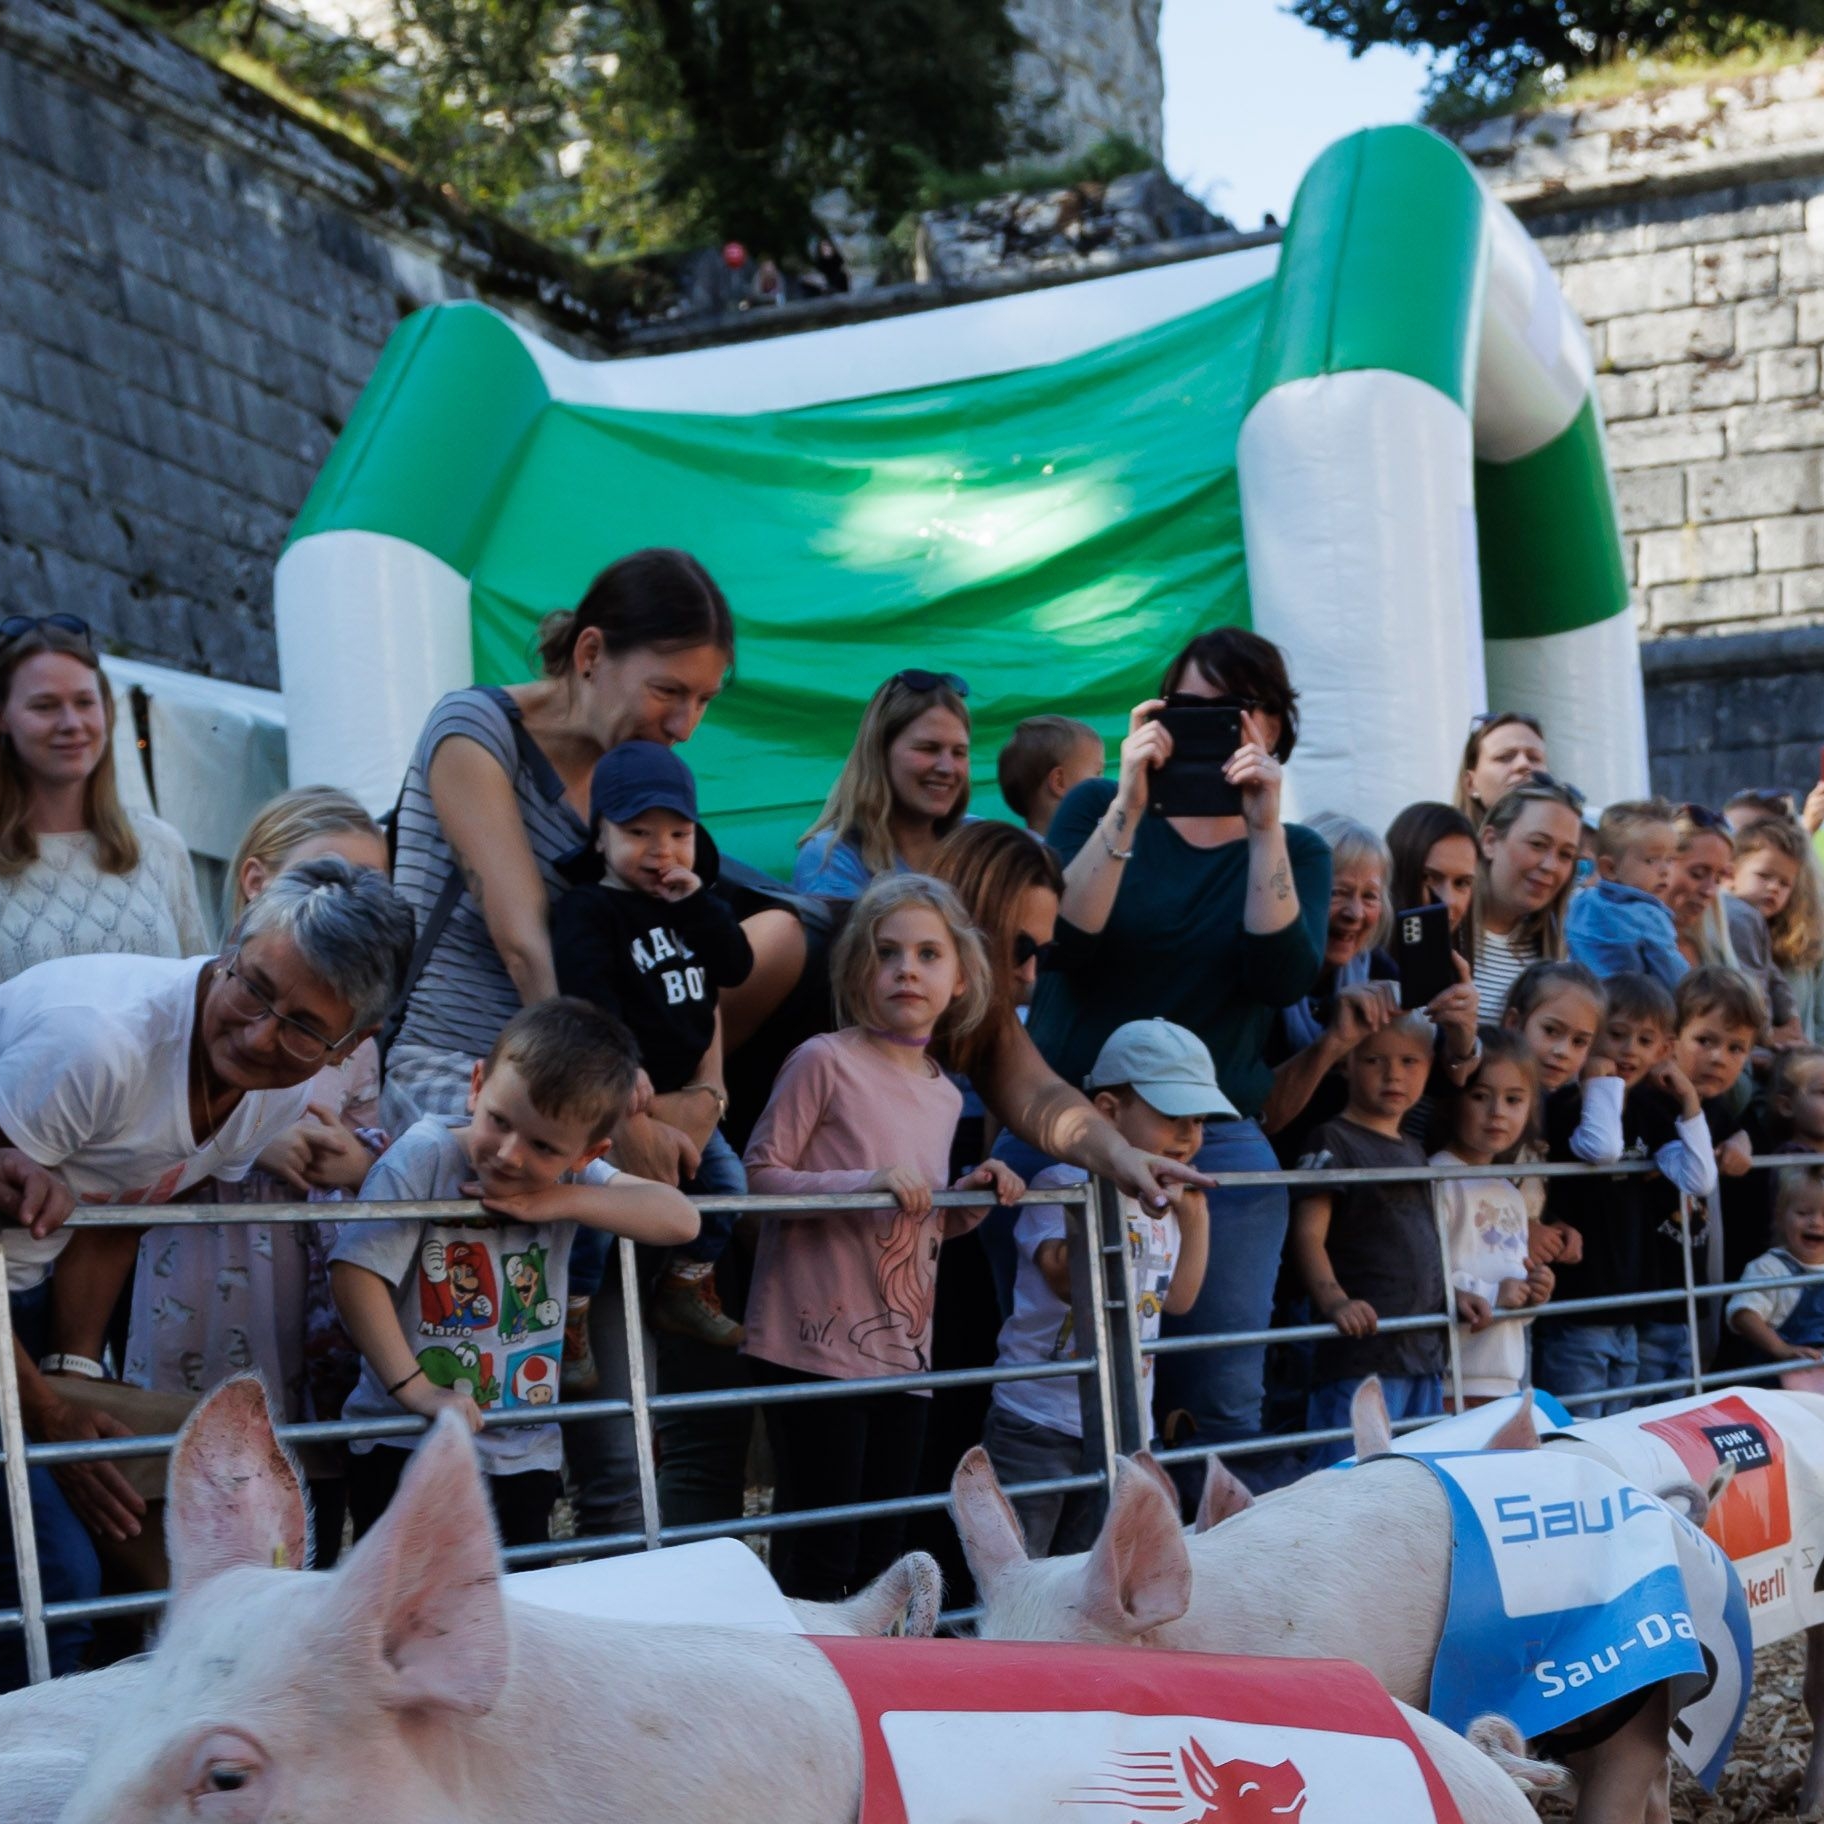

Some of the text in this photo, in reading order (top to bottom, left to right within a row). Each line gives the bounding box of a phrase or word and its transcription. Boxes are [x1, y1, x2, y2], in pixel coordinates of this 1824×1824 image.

[661, 966, 705, 1005] BO
[419, 1322, 474, 1338] Mario
[1713, 1429, 1753, 1450] FUNK
[1744, 1567, 1786, 1608] kerli
